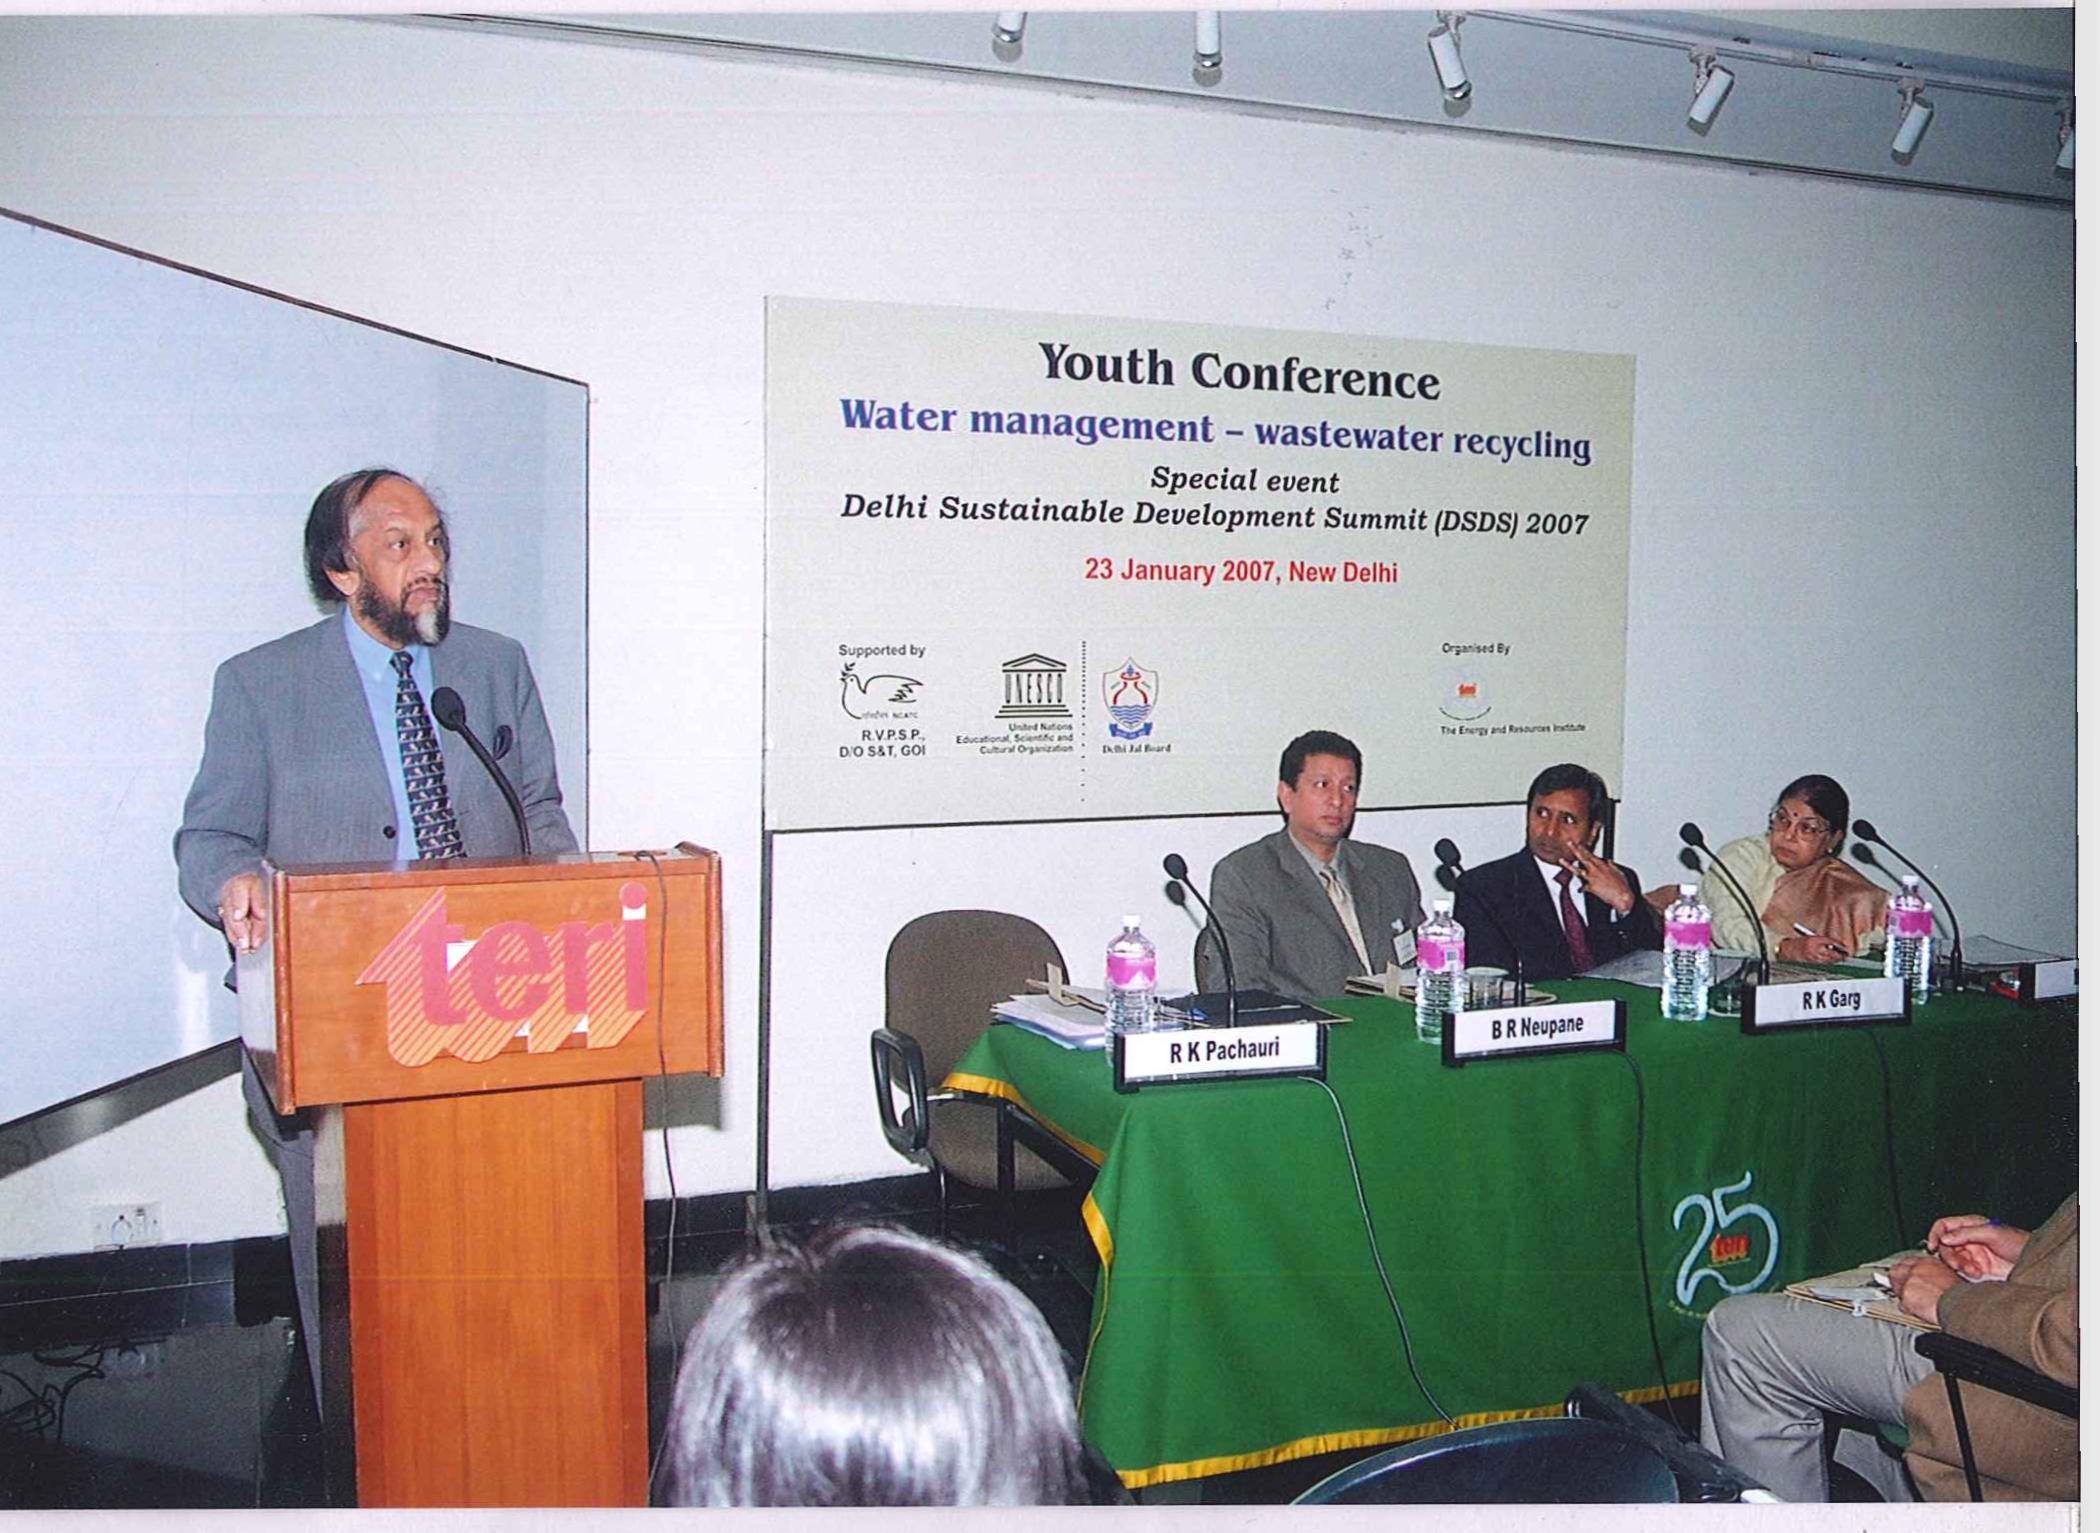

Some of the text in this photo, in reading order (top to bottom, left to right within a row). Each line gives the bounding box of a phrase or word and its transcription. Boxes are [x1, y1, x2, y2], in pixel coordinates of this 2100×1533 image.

[1039, 343, 1440, 400] Youth Conference
[840, 399, 957, 431] Water
[971, 412, 1214, 445] management
[1255, 421, 1443, 452] wastewater
[1454, 431, 1591, 466] recycling
[1151, 466, 1339, 495] Special event
[841, 494, 1589, 539] Delhi Sustainable Development Summit (DSDS) 2007
[1086, 558, 1397, 586] 23 January 2007, New Delhi
[839, 644, 926, 658] Supported by
[1442, 643, 1510, 655] Organised By
[1005, 673, 1063, 704] UNESCO
[956, 733, 1073, 745] Educational, Scientific and
[1009, 722, 1073, 733] United Nations
[1441, 723, 1586, 737] The Energy and Resources Institute
[868, 745, 896, 757] S&T,
[901, 744, 925, 756] GOI
[980, 743, 1073, 756] Cultural Organization
[1103, 743, 1171, 755] Delhi Jal Board
[356, 881, 646, 1048] teri
[1803, 989, 1860, 1010] R K Garg
[1492, 1016, 1584, 1039] B R Neupane
[1171, 1036, 1279, 1063] R K Pachauri
[1673, 1171, 1780, 1306] 25
